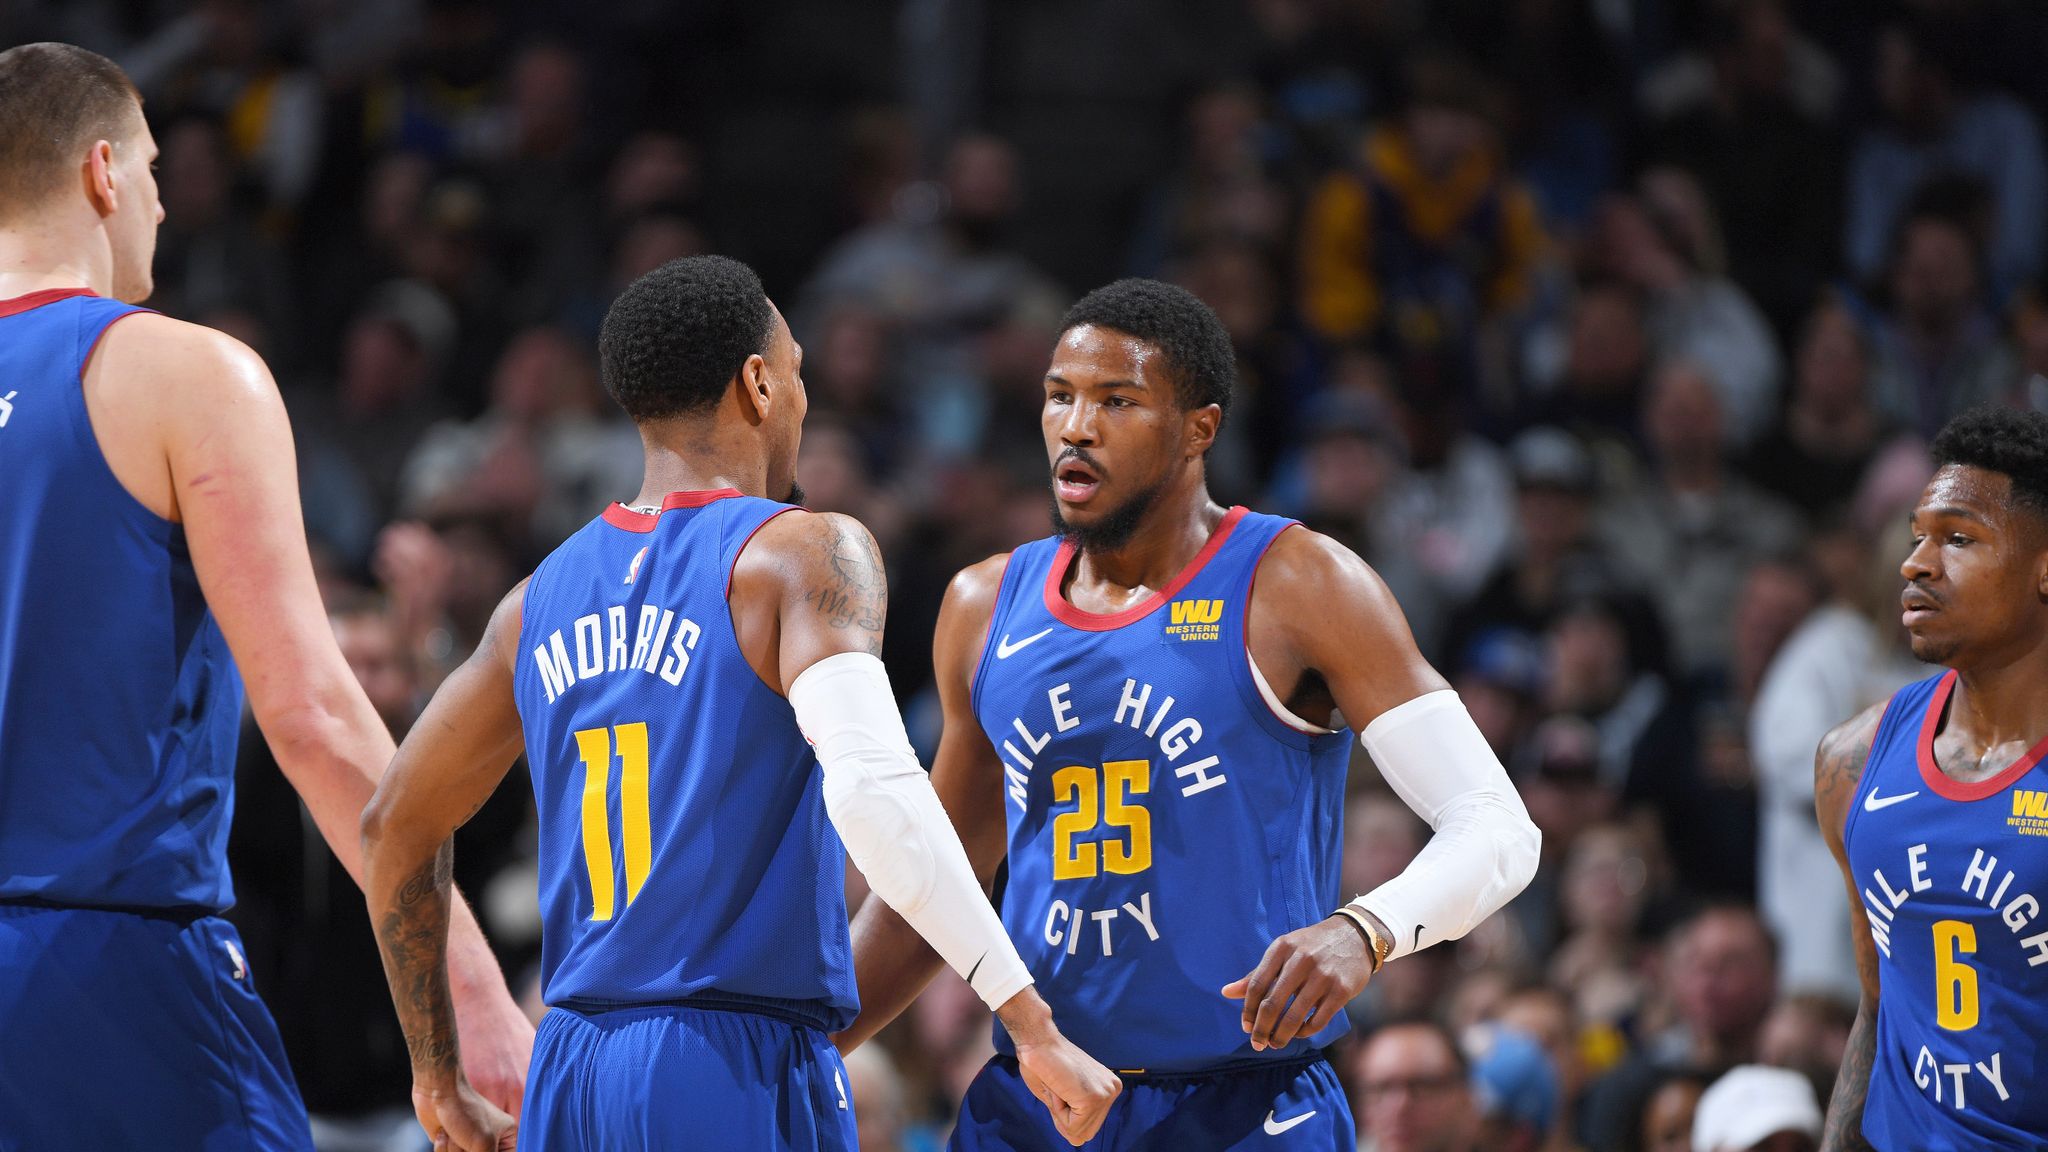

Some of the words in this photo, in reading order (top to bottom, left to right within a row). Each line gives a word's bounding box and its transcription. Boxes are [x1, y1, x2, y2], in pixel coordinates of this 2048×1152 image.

[1165, 624, 1219, 634] WESTERN
[1171, 599, 1224, 624] WU
[1181, 632, 1219, 641] UNION
[534, 604, 701, 704] MORRIS
[1003, 683, 1080, 812] MILE
[1114, 678, 1227, 798] HIGH
[574, 722, 652, 921] 11
[1051, 759, 1152, 880] 25
[2018, 826, 2048, 837] UNION
[1044, 892, 1160, 956] CITY
[1865, 843, 1932, 959] MILE
[1961, 848, 2048, 967] HIGH
[1931, 919, 1979, 1031] 6
[1914, 1045, 2010, 1109] CITY
